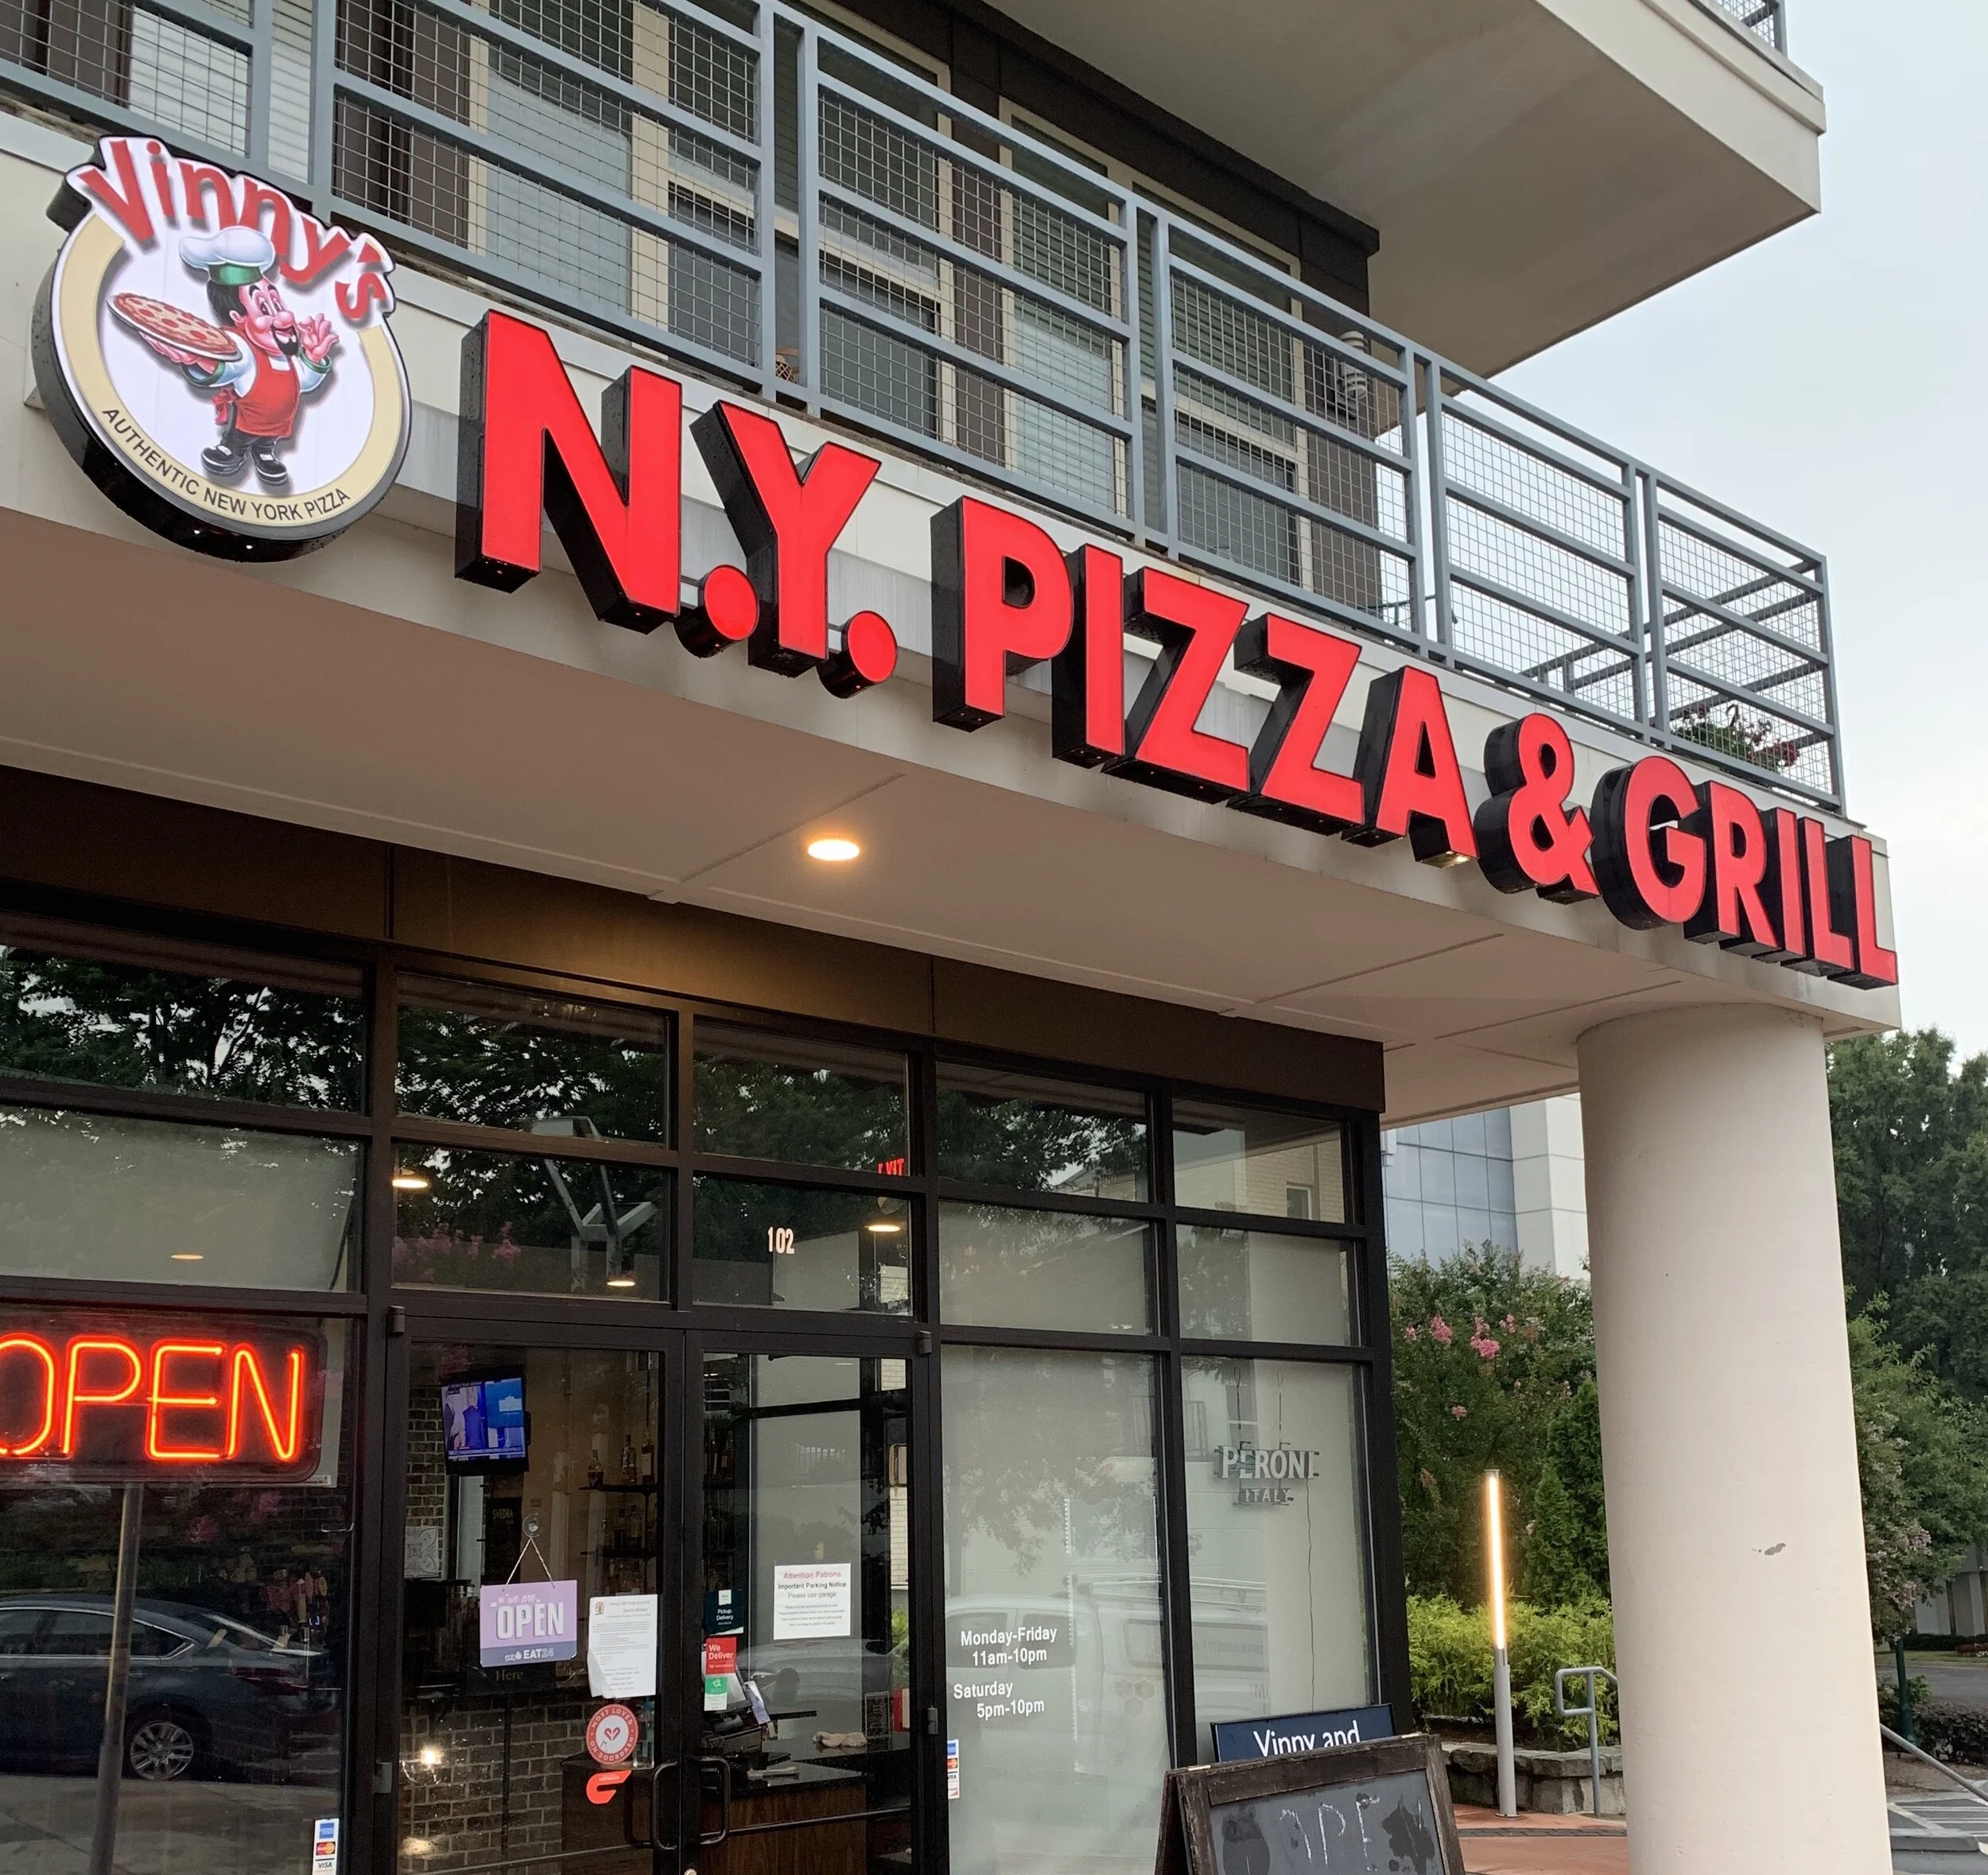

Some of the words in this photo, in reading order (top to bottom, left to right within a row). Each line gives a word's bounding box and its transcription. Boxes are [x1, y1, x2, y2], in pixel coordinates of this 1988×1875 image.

[81, 139, 386, 320] Vinny's
[102, 408, 200, 495] AUTHENTIC
[204, 487, 248, 515] NEW
[250, 501, 304, 521] YORK
[305, 488, 351, 518] PIZZA
[481, 310, 898, 684] N.Y.
[962, 497, 1478, 860] PIZZA
[1508, 712, 1600, 899] &
[1626, 755, 1898, 986] GRILL
[767, 1226, 795, 1254] 102
[1221, 1445, 1315, 1479] PERONI
[1245, 1489, 1291, 1503] ITALY
[496, 1601, 564, 1640] OPEN
[961, 1626, 1058, 1647] Monday-Friday
[973, 1648, 1047, 1667] 11am-10pm
[953, 1681, 1013, 1699] Saturday
[591, 1709, 610, 1729] MOST
[612, 1707, 634, 1726] LOVED
[977, 1699, 1045, 1721] 5pm-10pm
[598, 1737, 635, 1761] DOORDASH
[1253, 1729, 1315, 1757] Vinny
[1322, 1720, 1361, 1747] and
